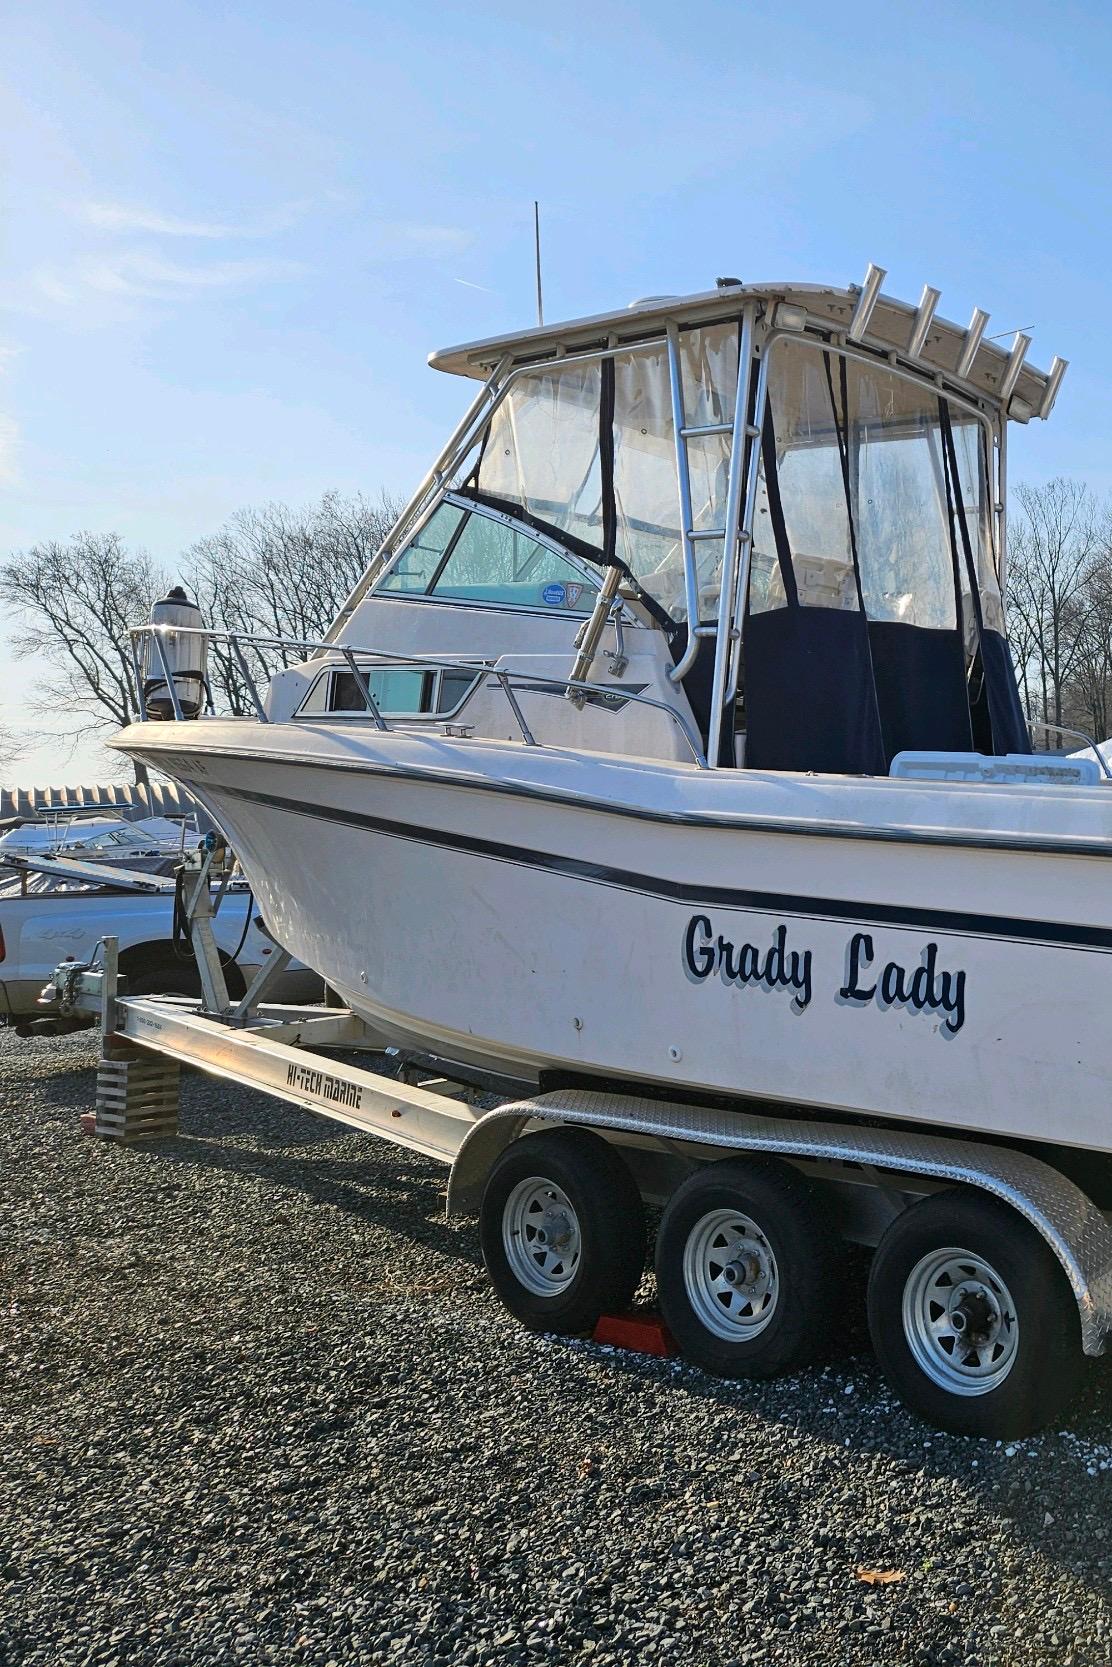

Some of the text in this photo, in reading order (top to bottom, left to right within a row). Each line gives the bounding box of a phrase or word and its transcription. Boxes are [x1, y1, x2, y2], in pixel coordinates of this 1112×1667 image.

[681, 914, 966, 1041] Grady Lady
[287, 1064, 322, 1095] HI-TECH
